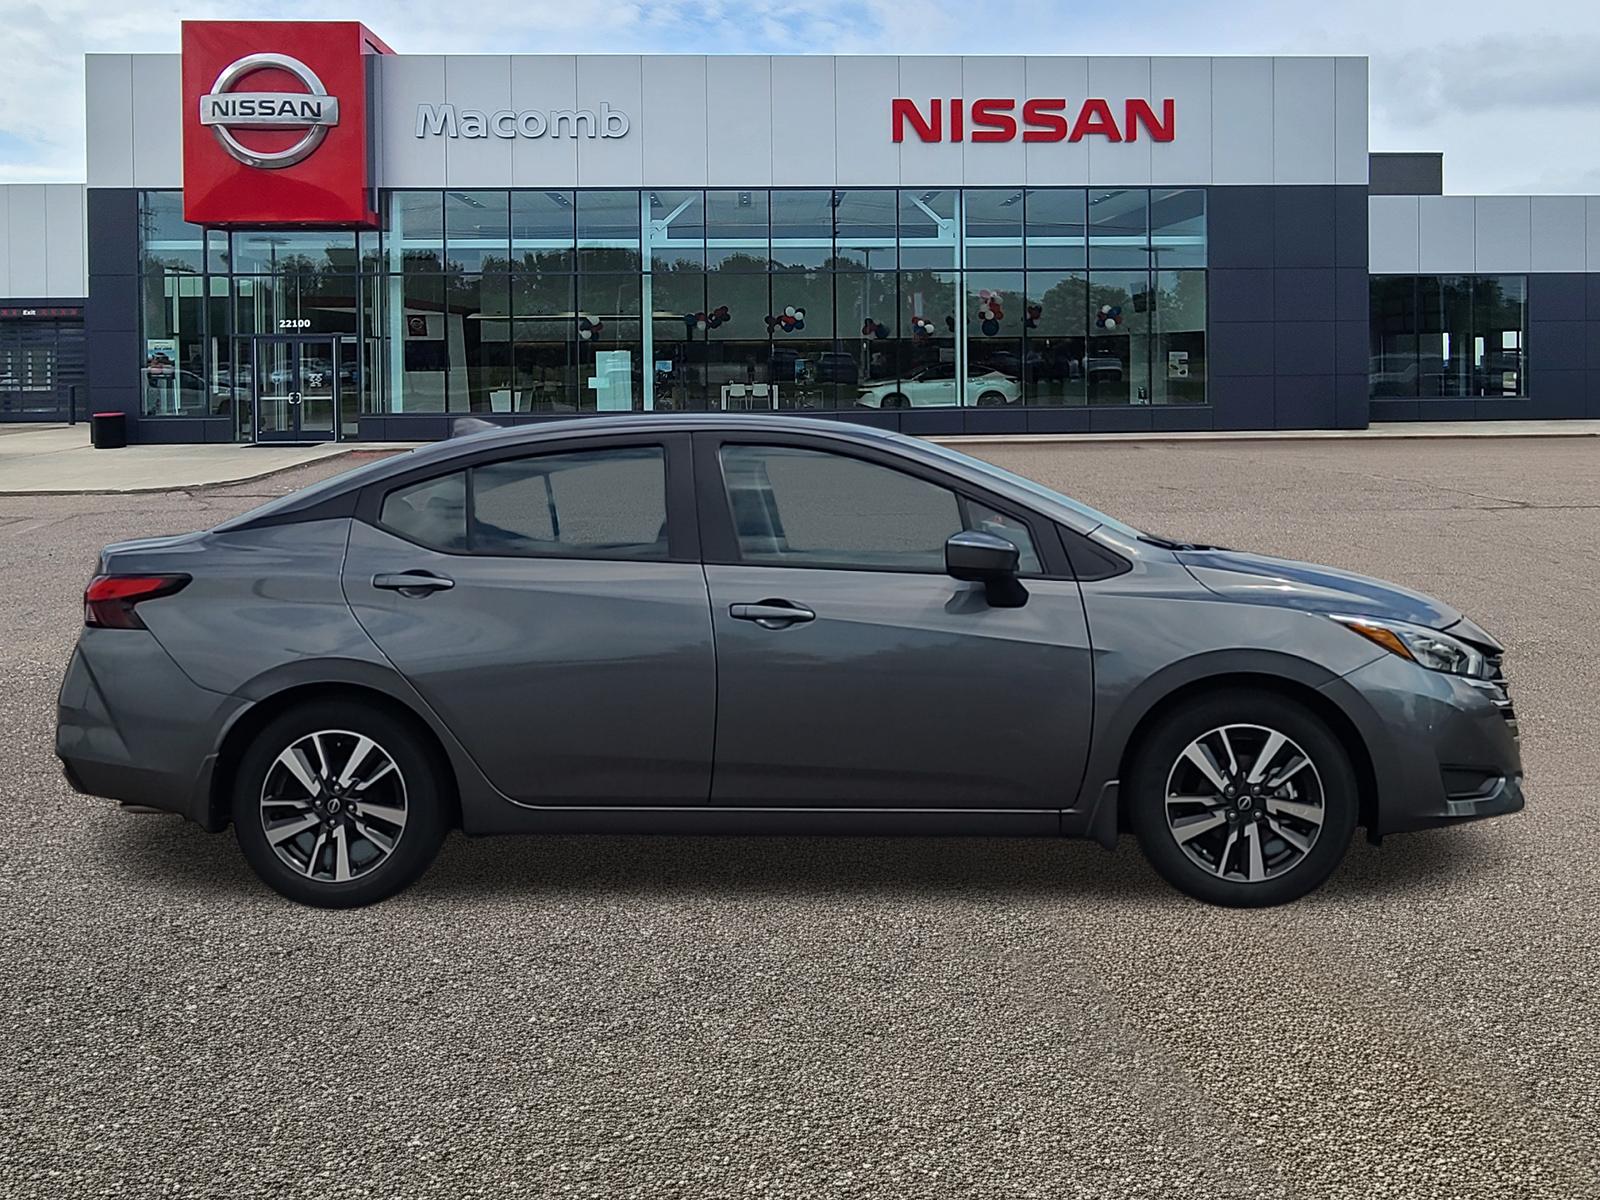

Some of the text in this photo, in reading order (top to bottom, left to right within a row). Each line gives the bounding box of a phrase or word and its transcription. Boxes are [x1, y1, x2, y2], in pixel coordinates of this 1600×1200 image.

[212, 100, 322, 117] NISSAN
[415, 102, 630, 139] Macomb
[892, 98, 1175, 143] NISSAN
[279, 319, 311, 328] 22100
